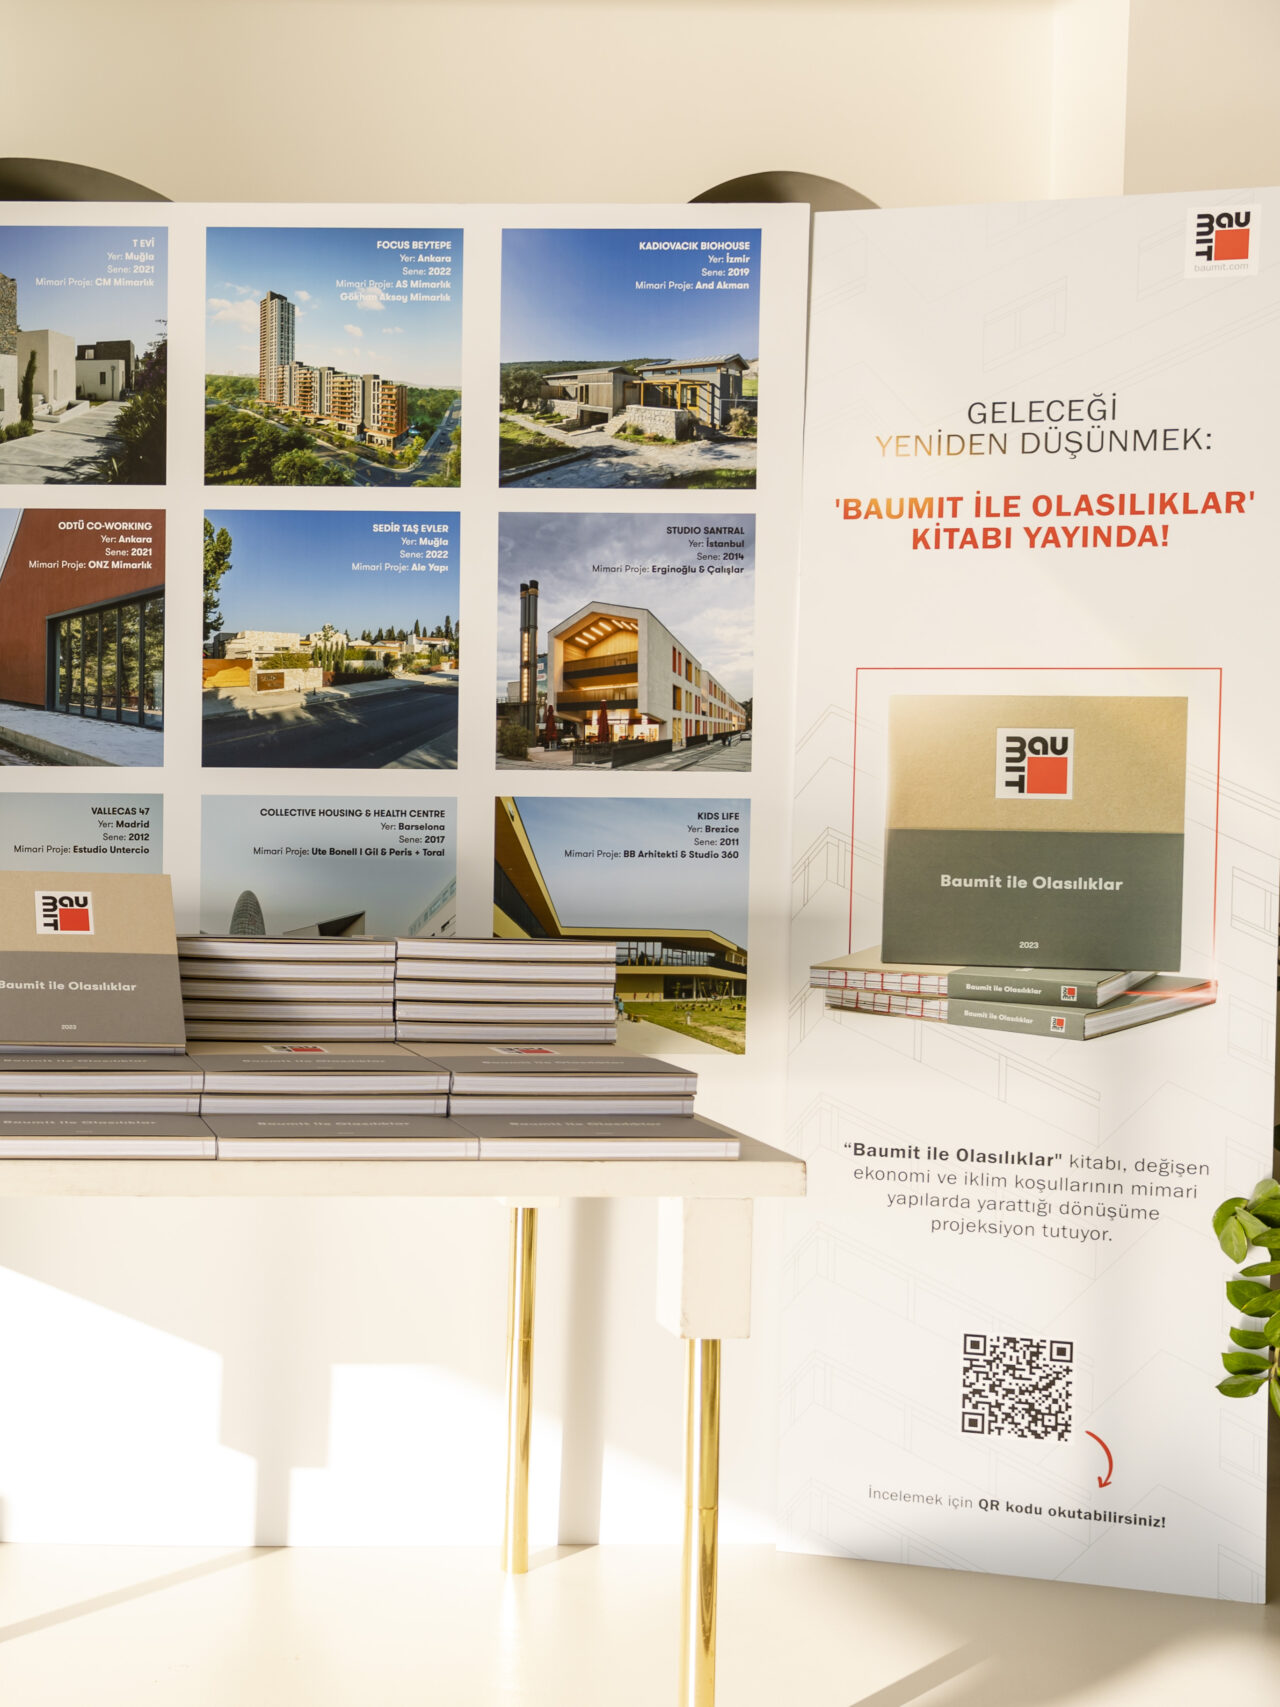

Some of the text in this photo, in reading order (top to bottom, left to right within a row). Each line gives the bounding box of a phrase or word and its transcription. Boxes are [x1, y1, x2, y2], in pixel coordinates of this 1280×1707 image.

[377, 241, 452, 249] FOCUS BEYTEPE
[701, 242, 750, 250] BIOHOUSE
[708, 255, 724, 263] Yer:
[1021, 425, 1212, 460] DÜŞÜNMEK:
[58, 520, 152, 530] ODTÜ CO-WORKING
[402, 525, 418, 534] TAŞ
[704, 527, 744, 535] SANTRAL
[101, 535, 116, 543] Yer:
[1023, 524, 1170, 548] YAYINDA!
[689, 540, 703, 548] Yer:
[105, 548, 152, 556] Sene: 2021
[62, 561, 86, 571] Proje:
[88, 561, 109, 569] ONZ
[112, 561, 152, 569] Mimarlık
[592, 565, 622, 573] Mimari
[625, 565, 650, 575] Proje:
[652, 565, 696, 575] Erginoğlu
[708, 565, 744, 575] Çalışlar
[319, 809, 362, 817] HOUSING
[409, 810, 445, 818] CENTRE
[98, 820, 149, 828] Yer: Madrid
[381, 823, 445, 831] Yer: Barselona
[688, 825, 702, 833] Yer:
[694, 838, 717, 846] Sene:
[47, 846, 70, 855] Proje:
[110, 846, 149, 854] Untercio
[254, 847, 282, 855] Mimari
[286, 847, 309, 857] Proje:
[365, 848, 378, 856] Gil
[389, 848, 412, 856] Peris
[423, 848, 444, 856] Toral
[565, 850, 594, 858] Mimari
[597, 851, 620, 860] Proje:
[941, 874, 1123, 890] Baumit ile Olasılıklar
[49, 981, 65, 990] ile
[68, 982, 136, 991] Olasılıklar
[927, 1146, 949, 1160] ile
[1070, 1154, 1127, 1173] kitabı,
[1135, 1158, 1210, 1178] değişen
[854, 1166, 1197, 1199] ekonomi ve iklim koşullarının mimari
[887, 1193, 1160, 1221] yapılarda yarattığı dönüşüme
[931, 1218, 1112, 1243] projeksiyon tutuyor.
[948, 1495, 973, 1509] için
[978, 1499, 1000, 1511] QR
[1005, 1501, 1042, 1516] kodu
[1048, 1506, 1166, 1528] okutabilirsiniz!
